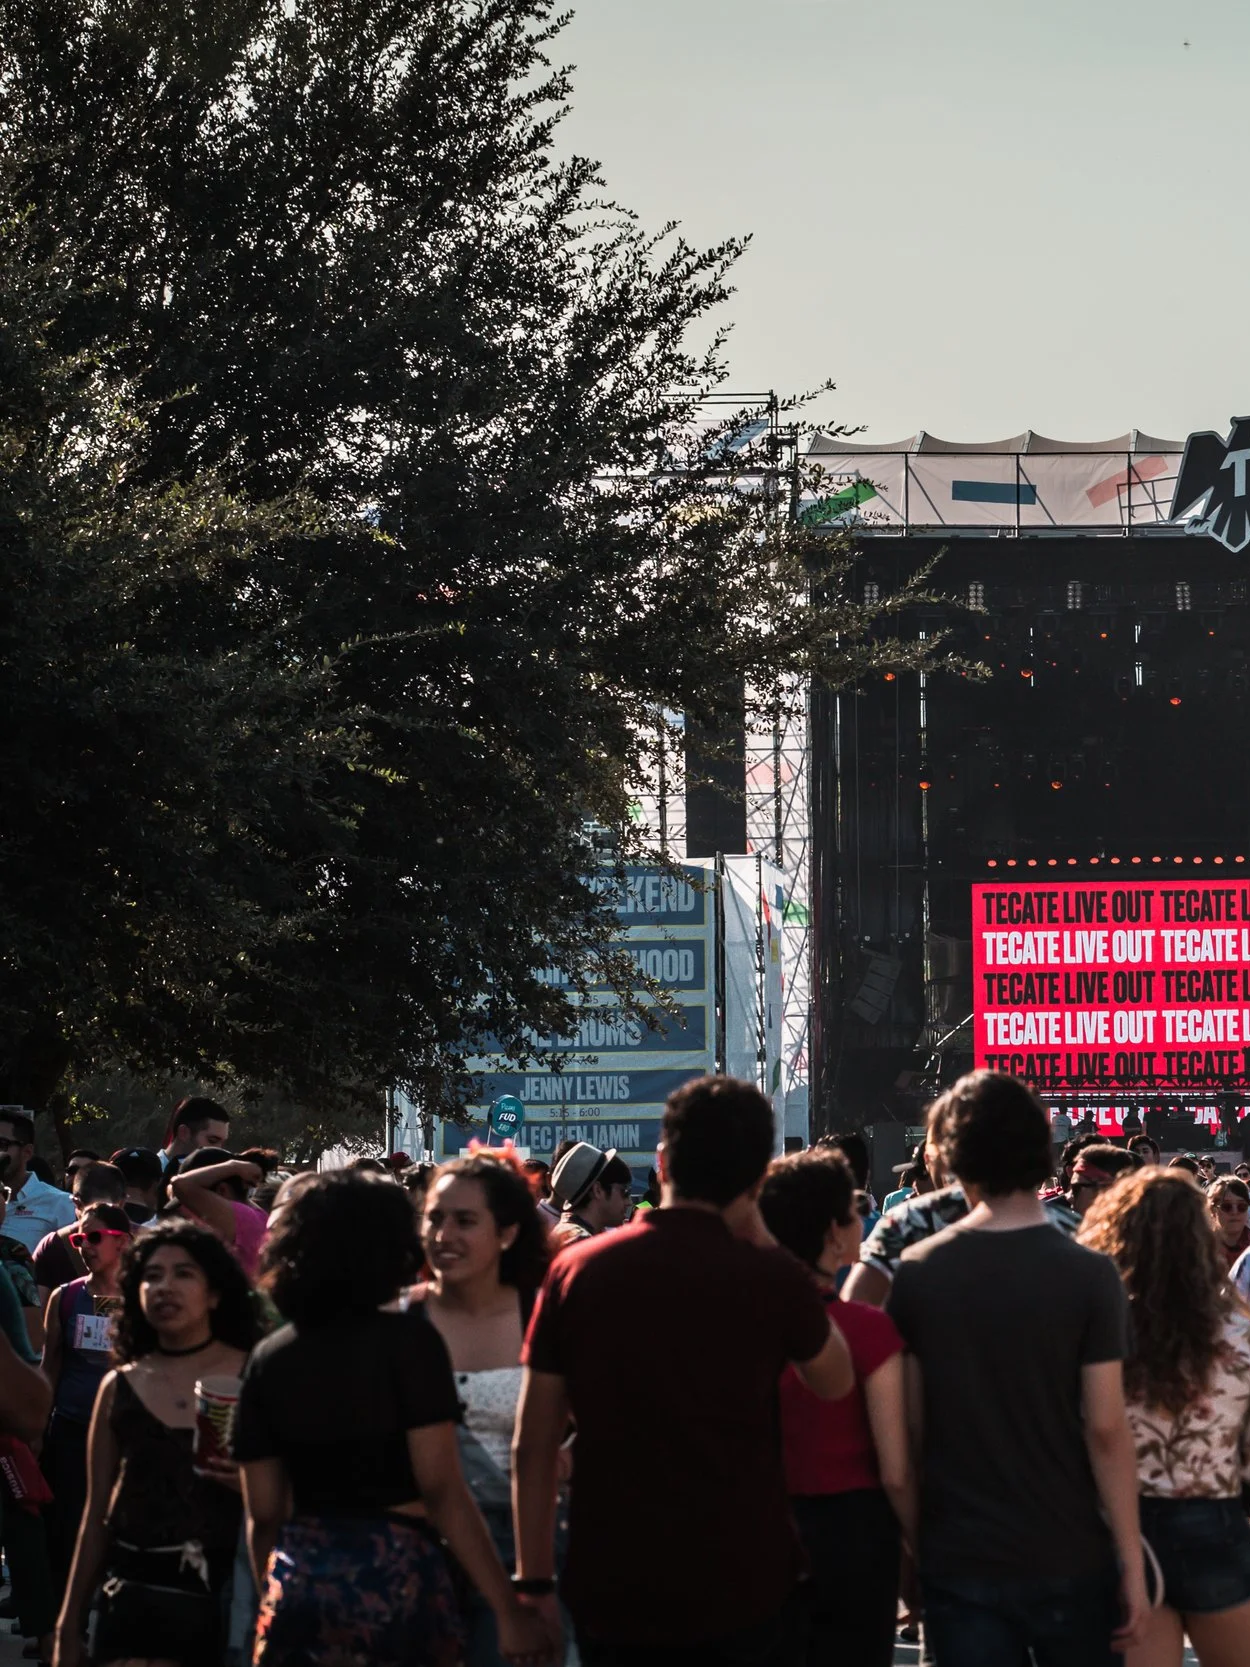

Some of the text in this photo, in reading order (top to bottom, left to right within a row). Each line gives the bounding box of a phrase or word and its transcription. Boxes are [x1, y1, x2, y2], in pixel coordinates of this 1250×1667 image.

[982, 892, 1059, 925] TECATE
[1063, 891, 1108, 923] LIVE
[1112, 890, 1154, 923] OUT
[1160, 889, 1237, 922] TECATE
[982, 931, 1060, 965] TECATE
[1063, 930, 1109, 963] LIVE
[1112, 929, 1155, 963] OUT
[1161, 928, 1238, 962] TECATE
[983, 972, 1060, 1005] TECATE
[1064, 972, 1109, 1004] LIVE
[1113, 971, 1155, 1003] OUT
[1162, 969, 1238, 1002] TECATE
[983, 1012, 1061, 1045] TECATE
[1065, 1011, 1110, 1044] LIVE
[1114, 1010, 1157, 1044] OUT
[1162, 1009, 1239, 1043] TECATE
[519, 1075, 630, 1101] JENNY LEWIS
[498, 1112, 516, 1122] FUD
[579, 1107, 601, 1117] 6:00
